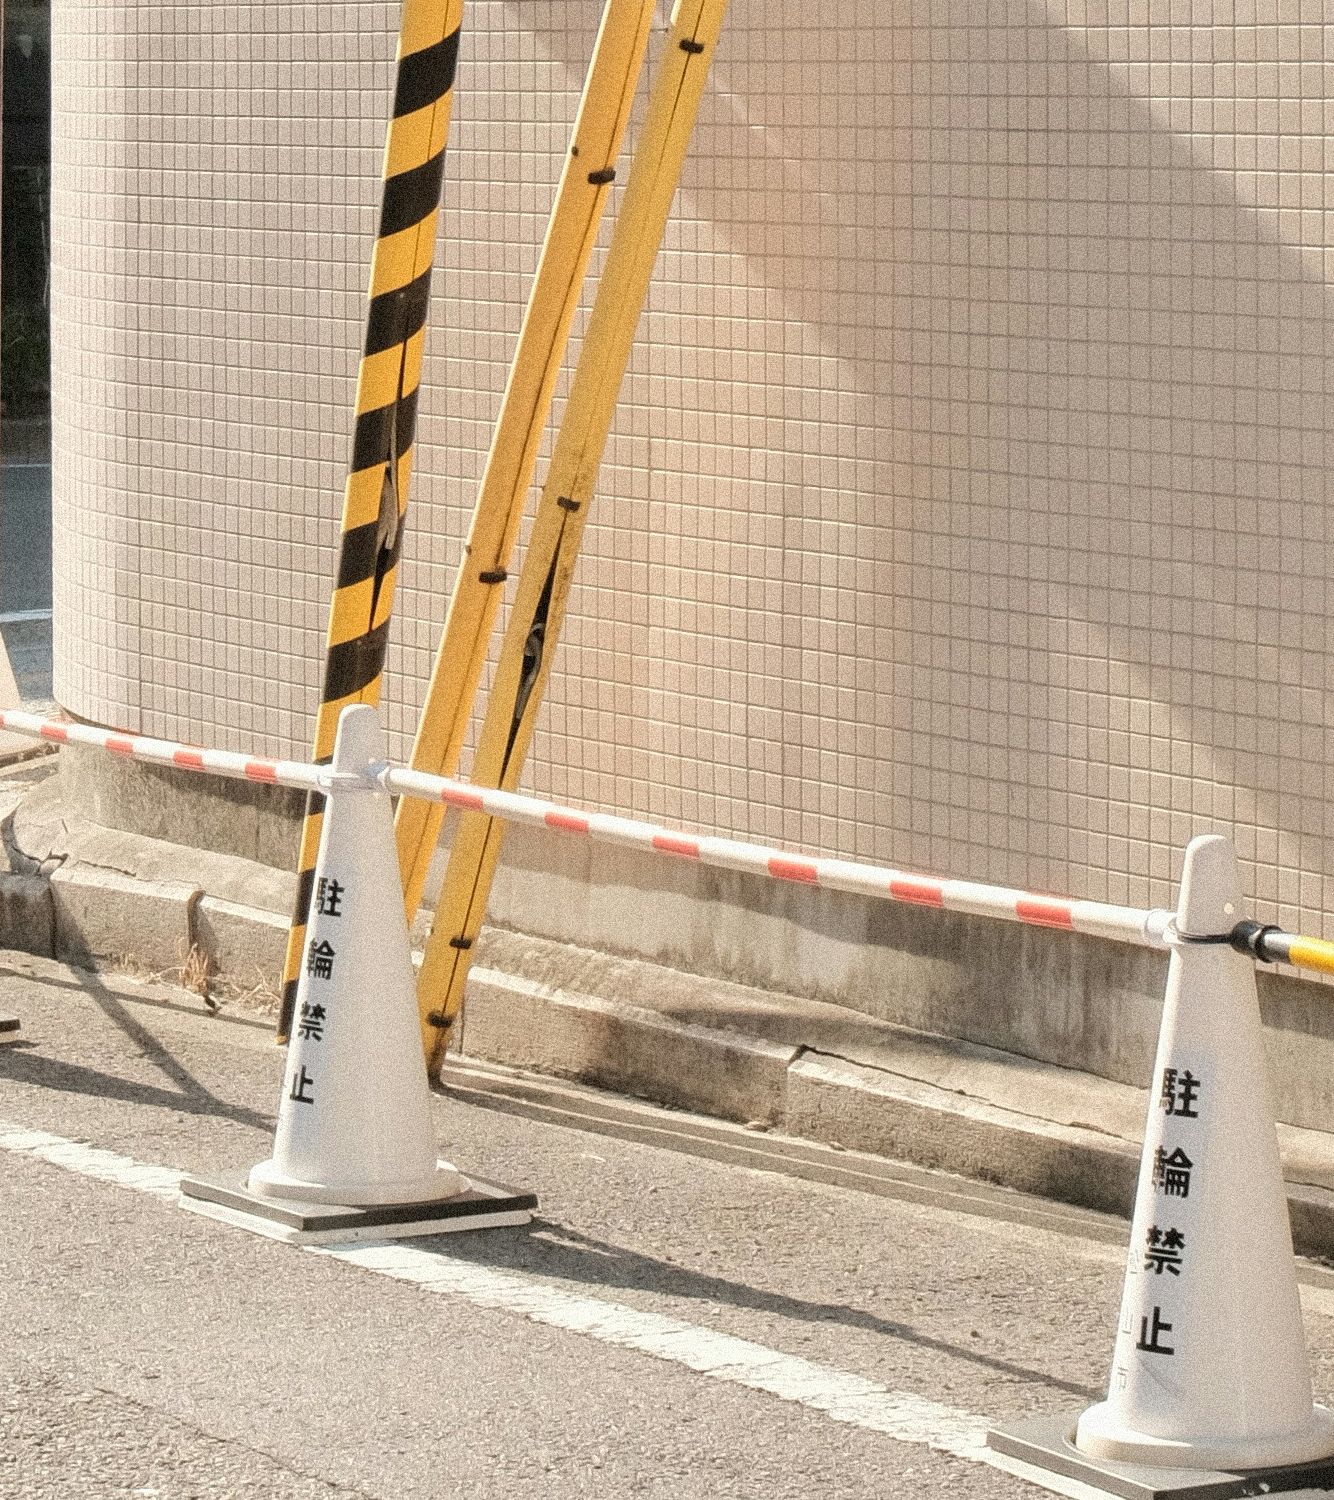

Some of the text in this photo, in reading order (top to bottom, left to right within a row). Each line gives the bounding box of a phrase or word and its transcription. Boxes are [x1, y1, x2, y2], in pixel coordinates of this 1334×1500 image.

[289, 876, 345, 1105] 駐輪禁止
[1136, 1067, 1202, 1356] 駐輪禁止
